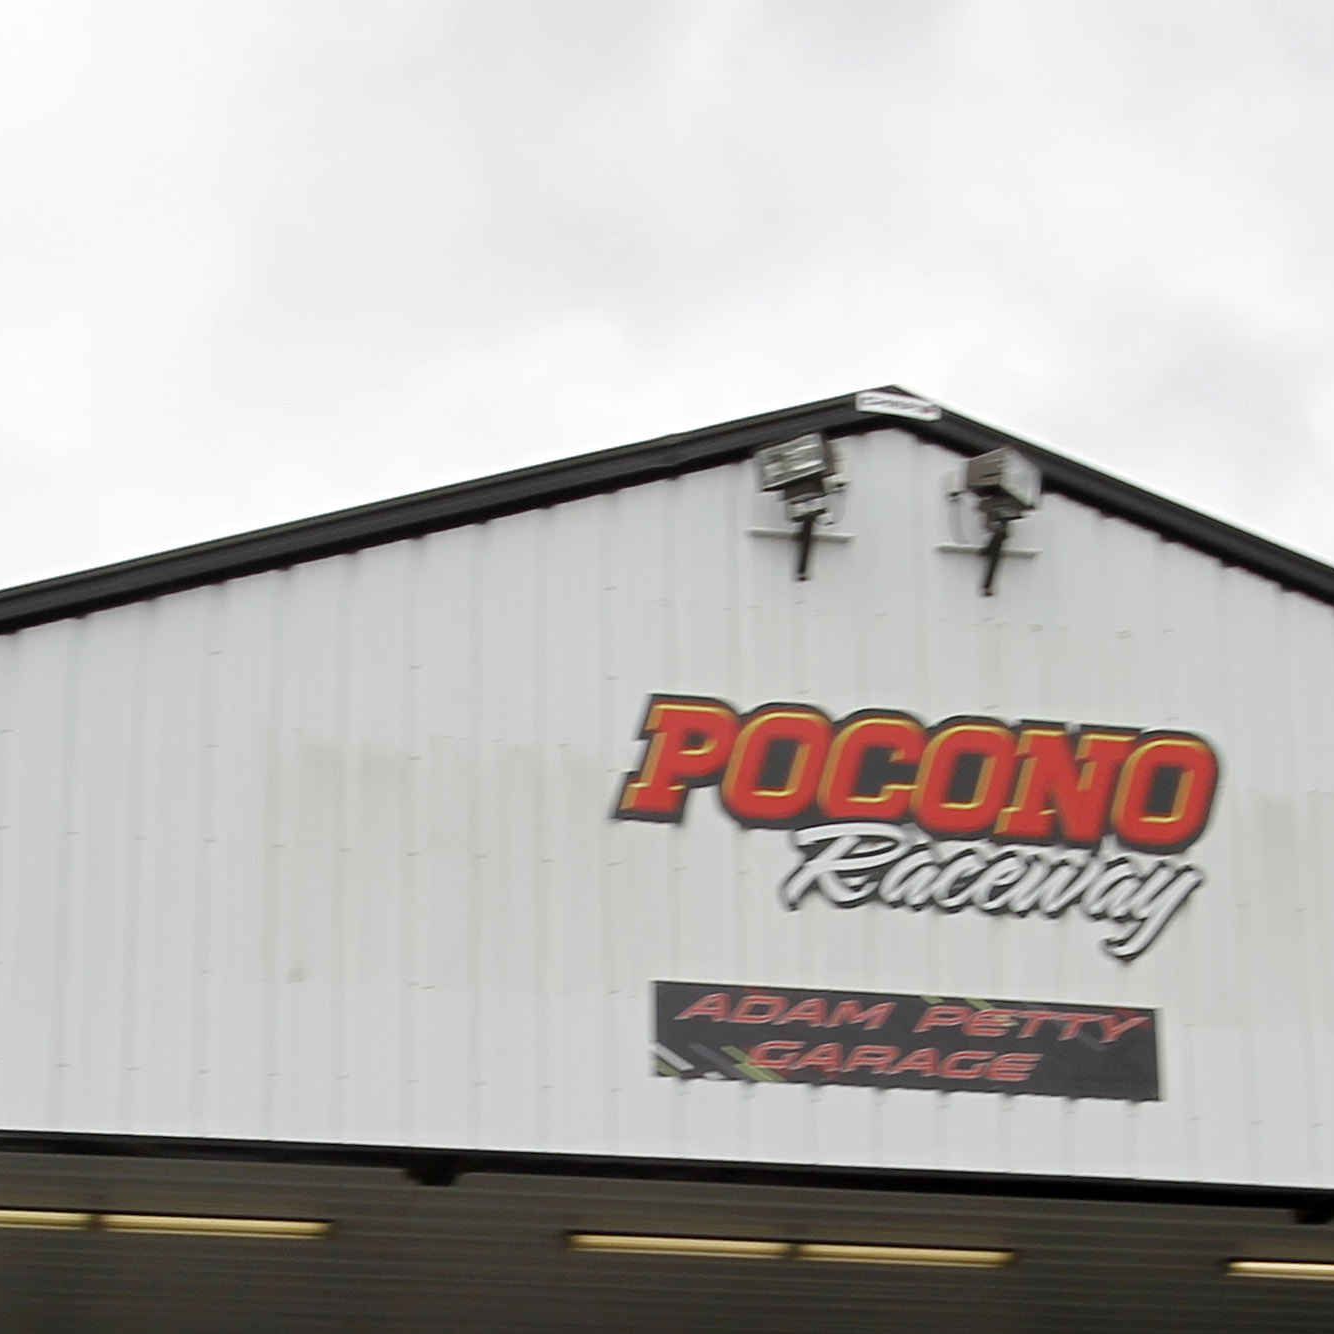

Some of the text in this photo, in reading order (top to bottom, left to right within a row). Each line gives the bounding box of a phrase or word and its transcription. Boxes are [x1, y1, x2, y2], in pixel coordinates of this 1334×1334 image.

[612, 693, 1219, 853] POCONO
[779, 823, 1205, 963] Raceway
[675, 993, 1150, 1044] ADAM PETTY
[743, 1040, 1043, 1081] GARAGE
